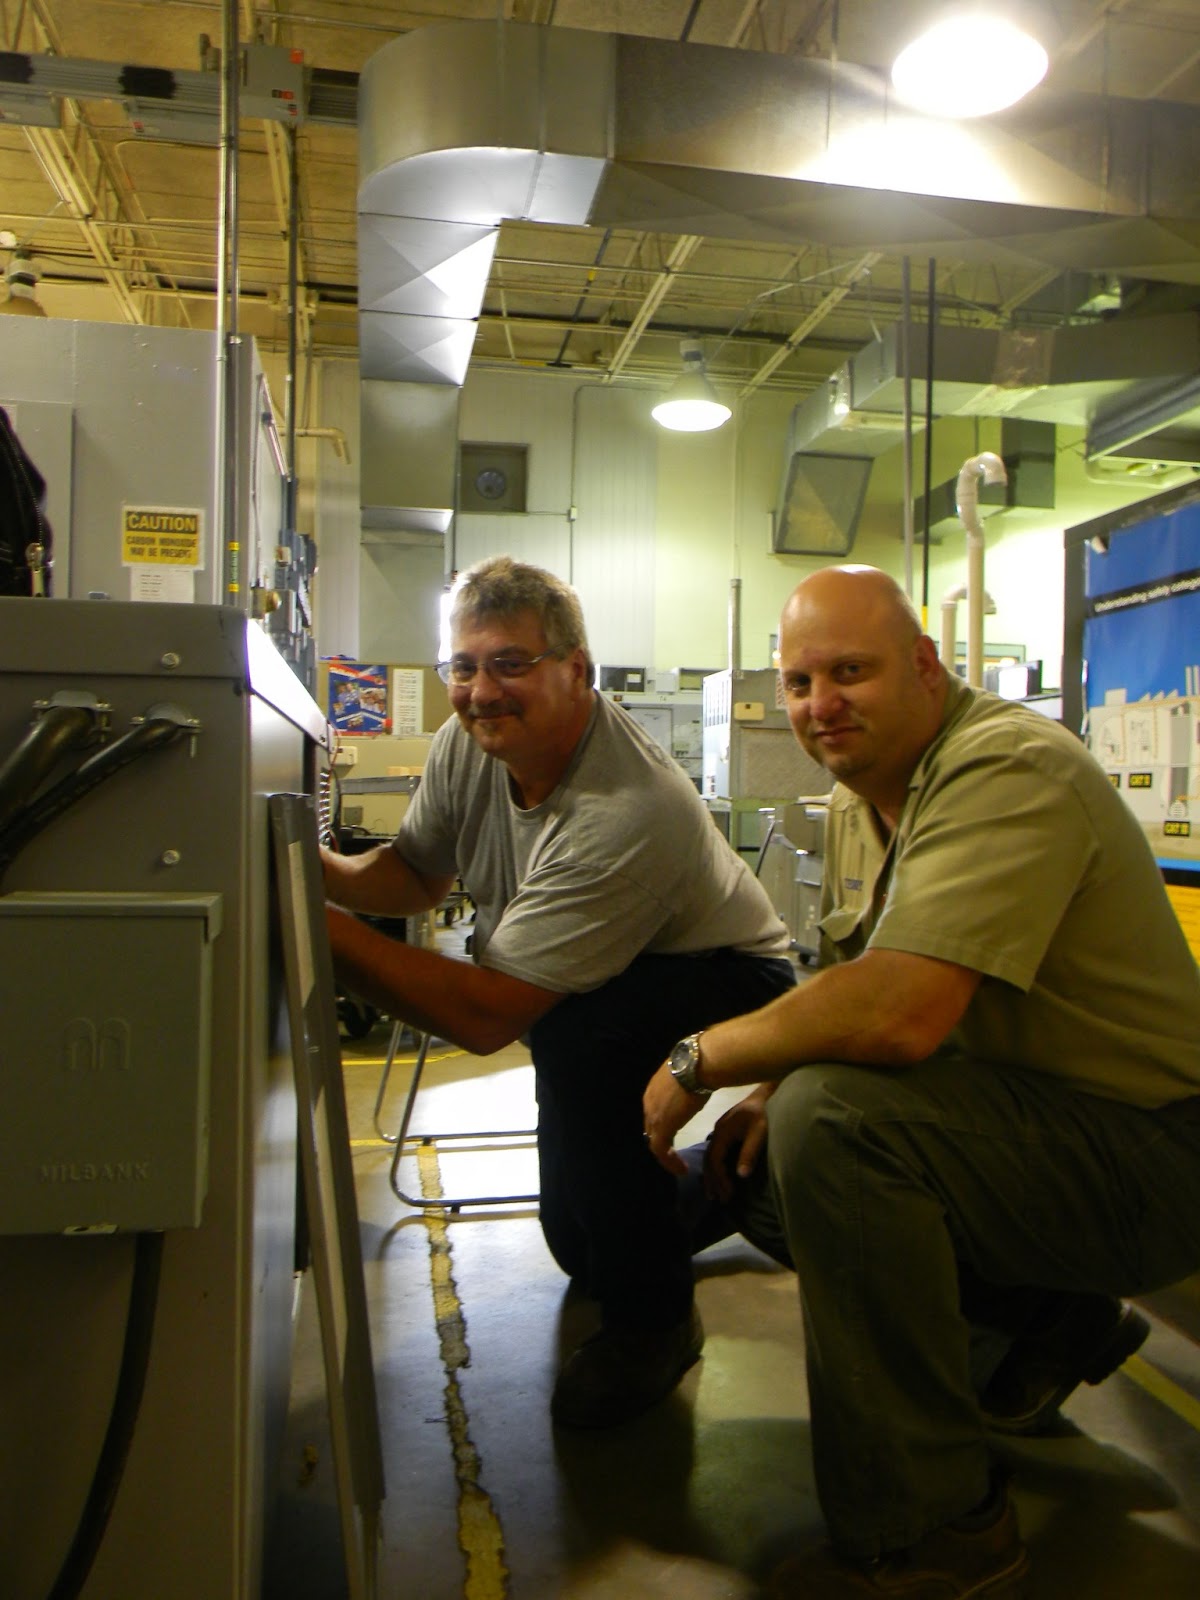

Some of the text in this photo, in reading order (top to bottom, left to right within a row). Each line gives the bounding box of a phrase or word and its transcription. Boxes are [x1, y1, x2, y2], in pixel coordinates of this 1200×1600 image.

[127, 514, 195, 531] CAUTION
[126, 537, 197, 548] CARBON MONOXIDE
[130, 547, 192, 558] MAY BE PRESENT
[40, 1162, 149, 1182] MILBANK
